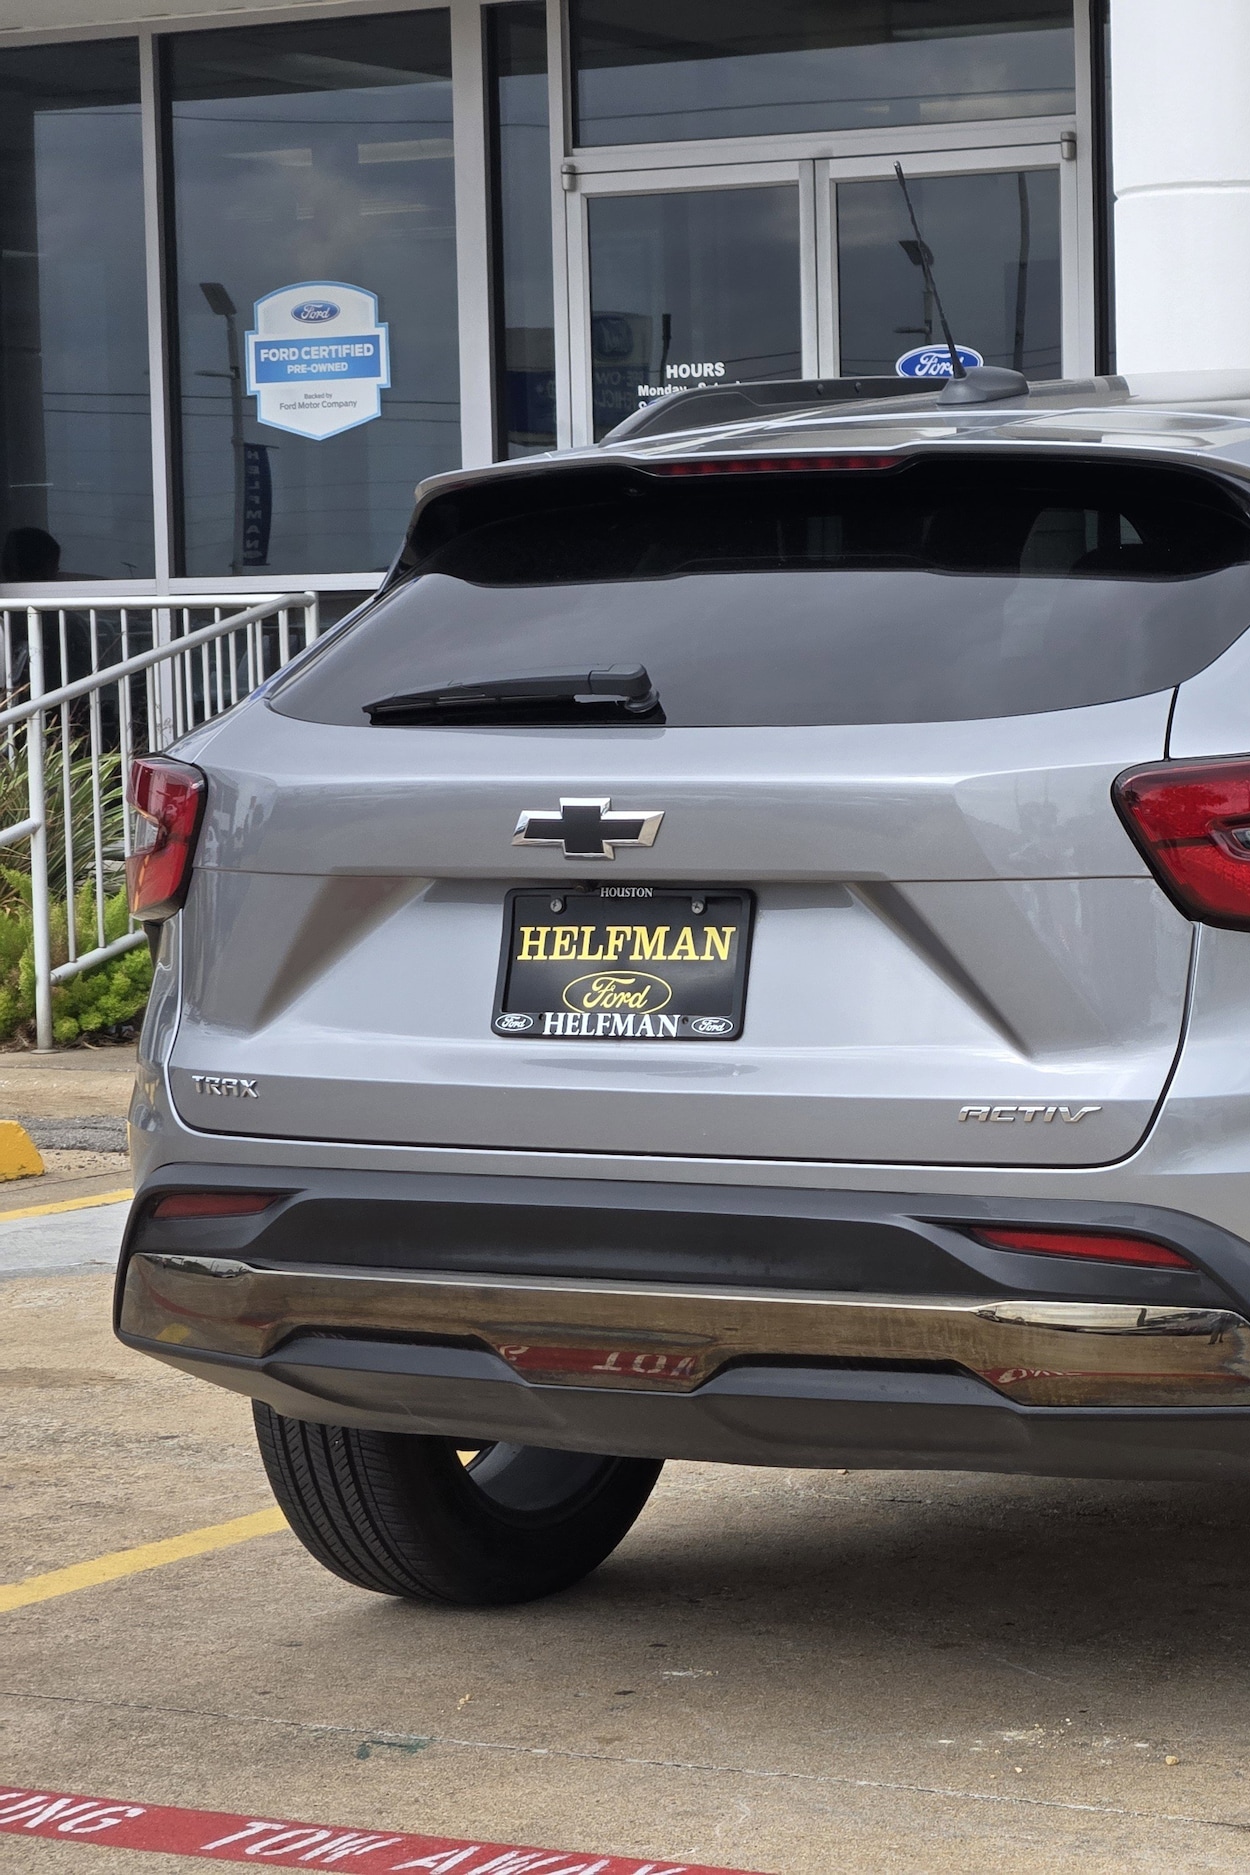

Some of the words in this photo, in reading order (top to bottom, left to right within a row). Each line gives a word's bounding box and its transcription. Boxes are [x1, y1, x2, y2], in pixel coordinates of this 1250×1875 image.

[301, 304, 331, 320] Ford
[260, 347, 299, 362] FORD
[301, 343, 374, 361] CERTIFIED
[287, 361, 349, 375] PRE-OWNED
[666, 361, 726, 379] HOURS
[280, 402, 297, 410] Ford
[298, 401, 320, 409] Motor
[321, 400, 358, 409] Company
[325, 392, 333, 400] by
[600, 887, 653, 898] HOUSTON
[516, 925, 737, 961] HELFMAN
[582, 976, 651, 1009] Ford
[501, 1016, 526, 1029] Ford
[542, 1011, 681, 1038] HELFMAN
[697, 1019, 726, 1033] Ford
[191, 1075, 260, 1098] TRAX
[958, 1105, 1102, 1123] ACTIV
[200, 1821, 403, 1863] TOW
